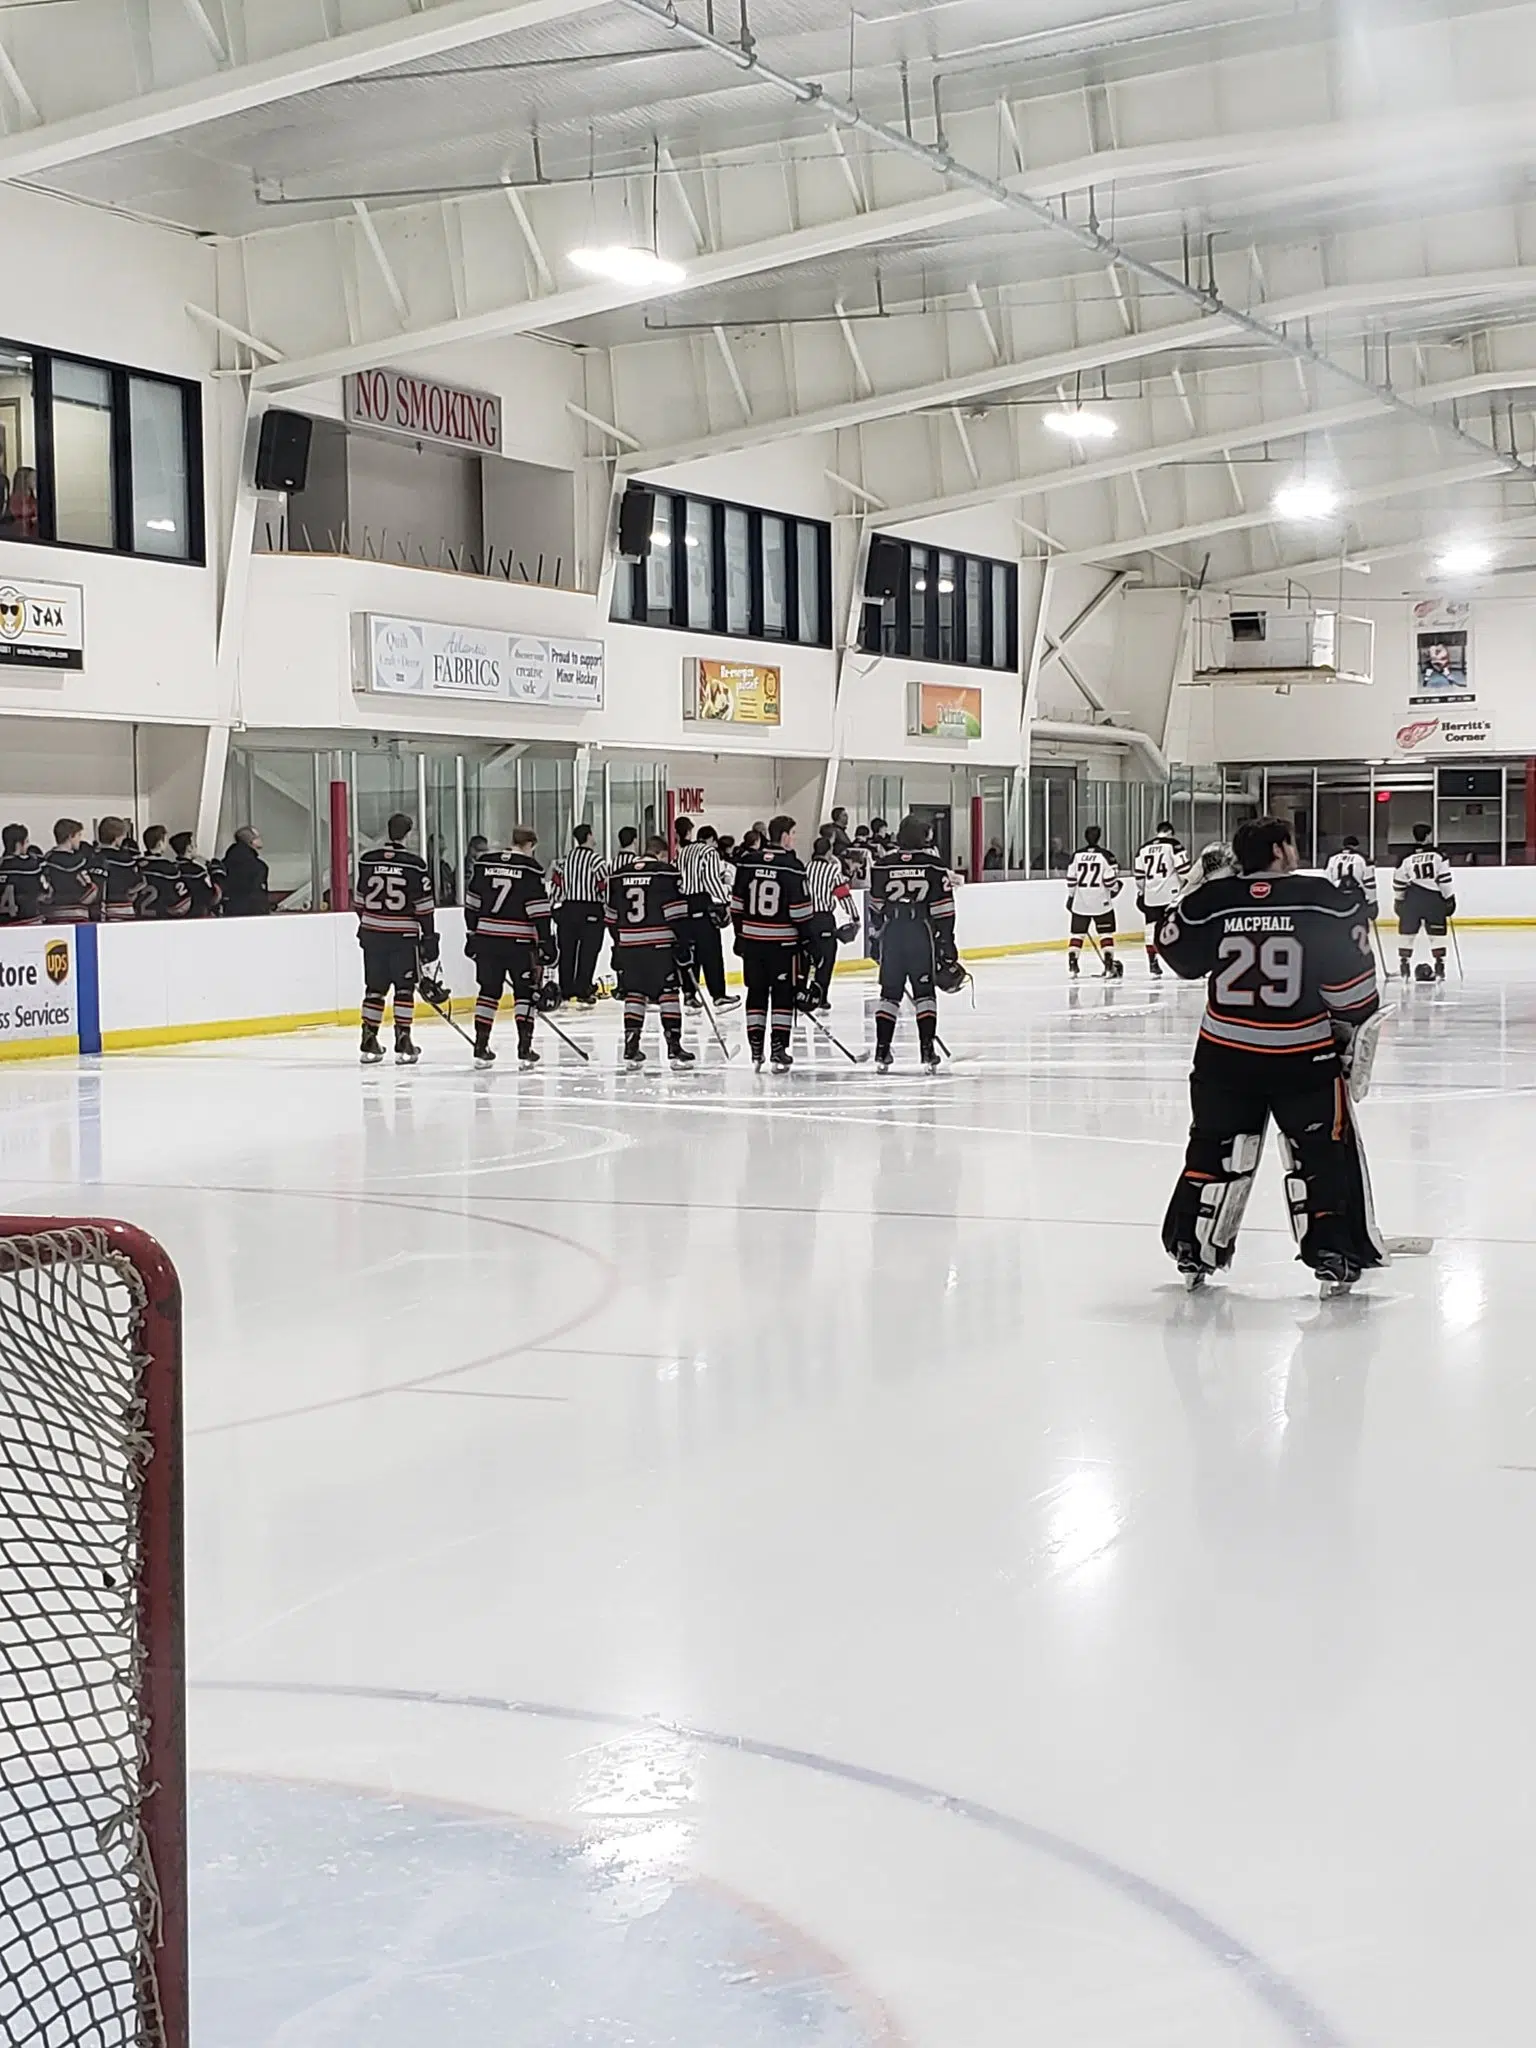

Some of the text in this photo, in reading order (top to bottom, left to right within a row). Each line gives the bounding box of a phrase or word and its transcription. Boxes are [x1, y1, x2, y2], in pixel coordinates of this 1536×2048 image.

[356, 370, 497, 447] NO SMOKING
[31, 604, 64, 627] JAX
[433, 654, 500, 687] FABRICS
[551, 647, 602, 670] Proud to support
[576, 669, 598, 690] Hockey
[1441, 720, 1491, 732] Herritt's
[1445, 733, 1486, 742] Corner
[679, 787, 705, 814] HOME
[1077, 862, 1101, 888] 22
[1144, 853, 1168, 880] 24
[365, 875, 407, 911] 25
[490, 877, 513, 914] 7
[748, 878, 781, 917] 18
[885, 880, 930, 902] 27
[626, 887, 646, 923] 3
[1223, 916, 1295, 933] MACPHAIL
[47, 954, 68, 979] ups
[1215, 935, 1304, 1009] 29
[15, 1001, 70, 1028] Services
